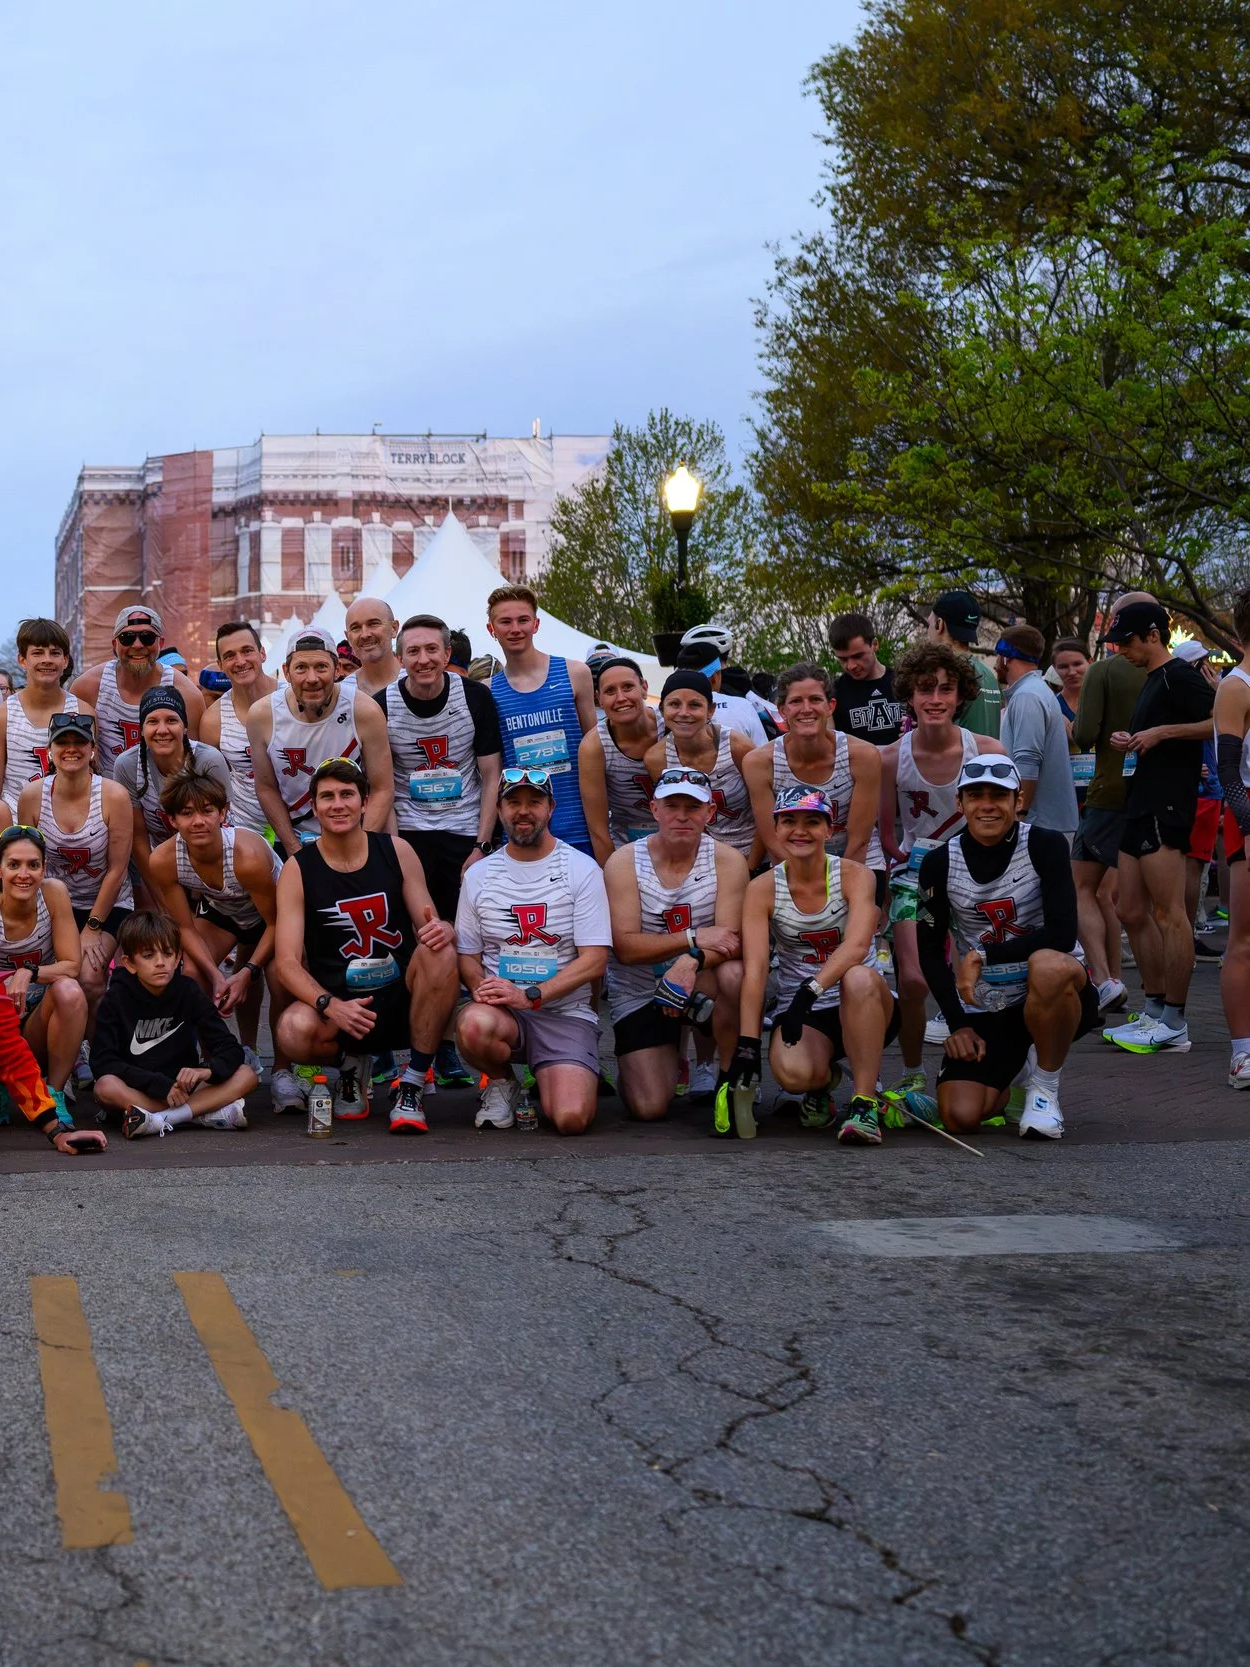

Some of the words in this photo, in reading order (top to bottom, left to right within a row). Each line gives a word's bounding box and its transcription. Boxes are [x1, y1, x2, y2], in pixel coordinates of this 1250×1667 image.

[391, 453, 426, 464] TERRY
[429, 453, 465, 464] BLOCK
[505, 708, 564, 731] BENTONVILLE
[518, 744, 566, 762] 2784
[416, 782, 456, 794] 1367
[339, 892, 403, 959] R
[505, 963, 549, 975] 1056
[135, 1017, 174, 1038] NIKE
